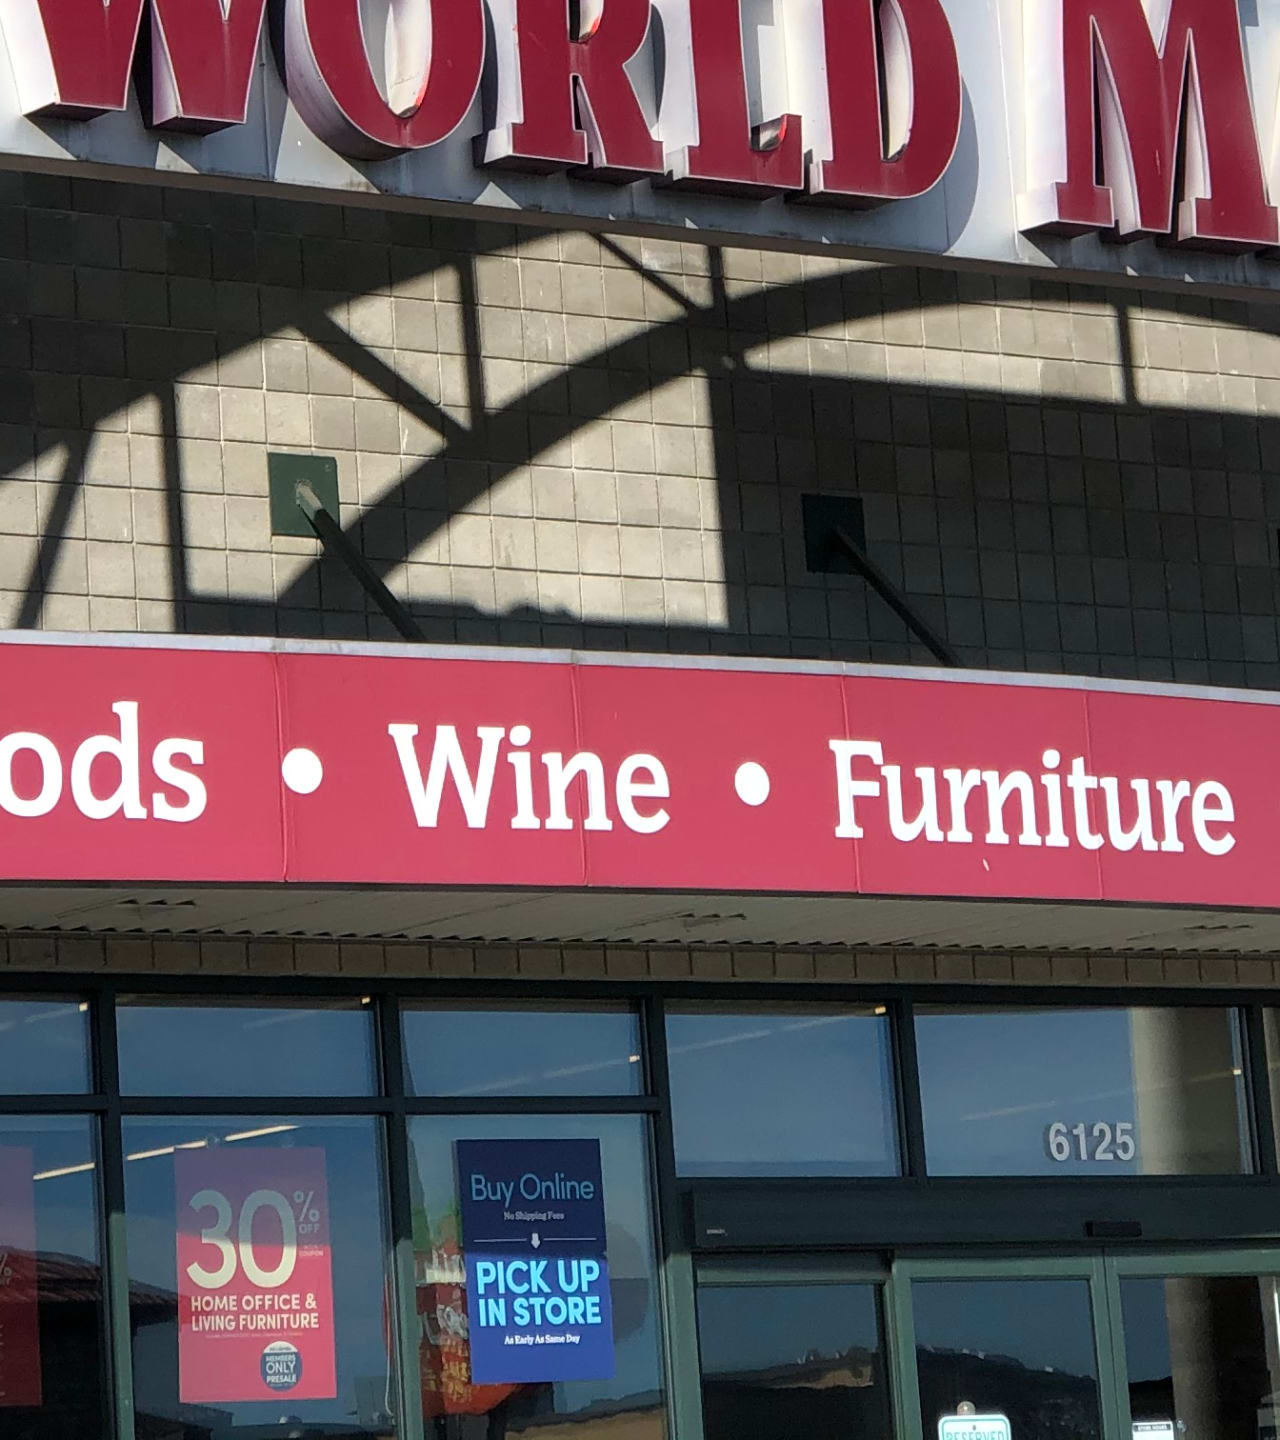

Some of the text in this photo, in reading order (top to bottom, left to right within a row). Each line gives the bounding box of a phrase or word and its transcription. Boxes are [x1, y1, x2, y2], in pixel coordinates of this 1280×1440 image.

[388, 723, 671, 835] Wine
[829, 739, 1237, 857] Furniture
[1048, 1122, 1136, 1161] 6125
[470, 1171, 595, 1209] Buy Online
[503, 1211, 515, 1221] No
[299, 1223, 320, 1234] OFF
[475, 1259, 600, 1295] PICK UP
[191, 1292, 318, 1312] HOME OFFICE &
[478, 1295, 602, 1327] IN STORE
[191, 1312, 320, 1332] LIVING FURNITURE
[504, 1333, 581, 1346] As Early As Same Day
[265, 1361, 297, 1374] ONLY
[266, 1374, 297, 1384] PRESALE
